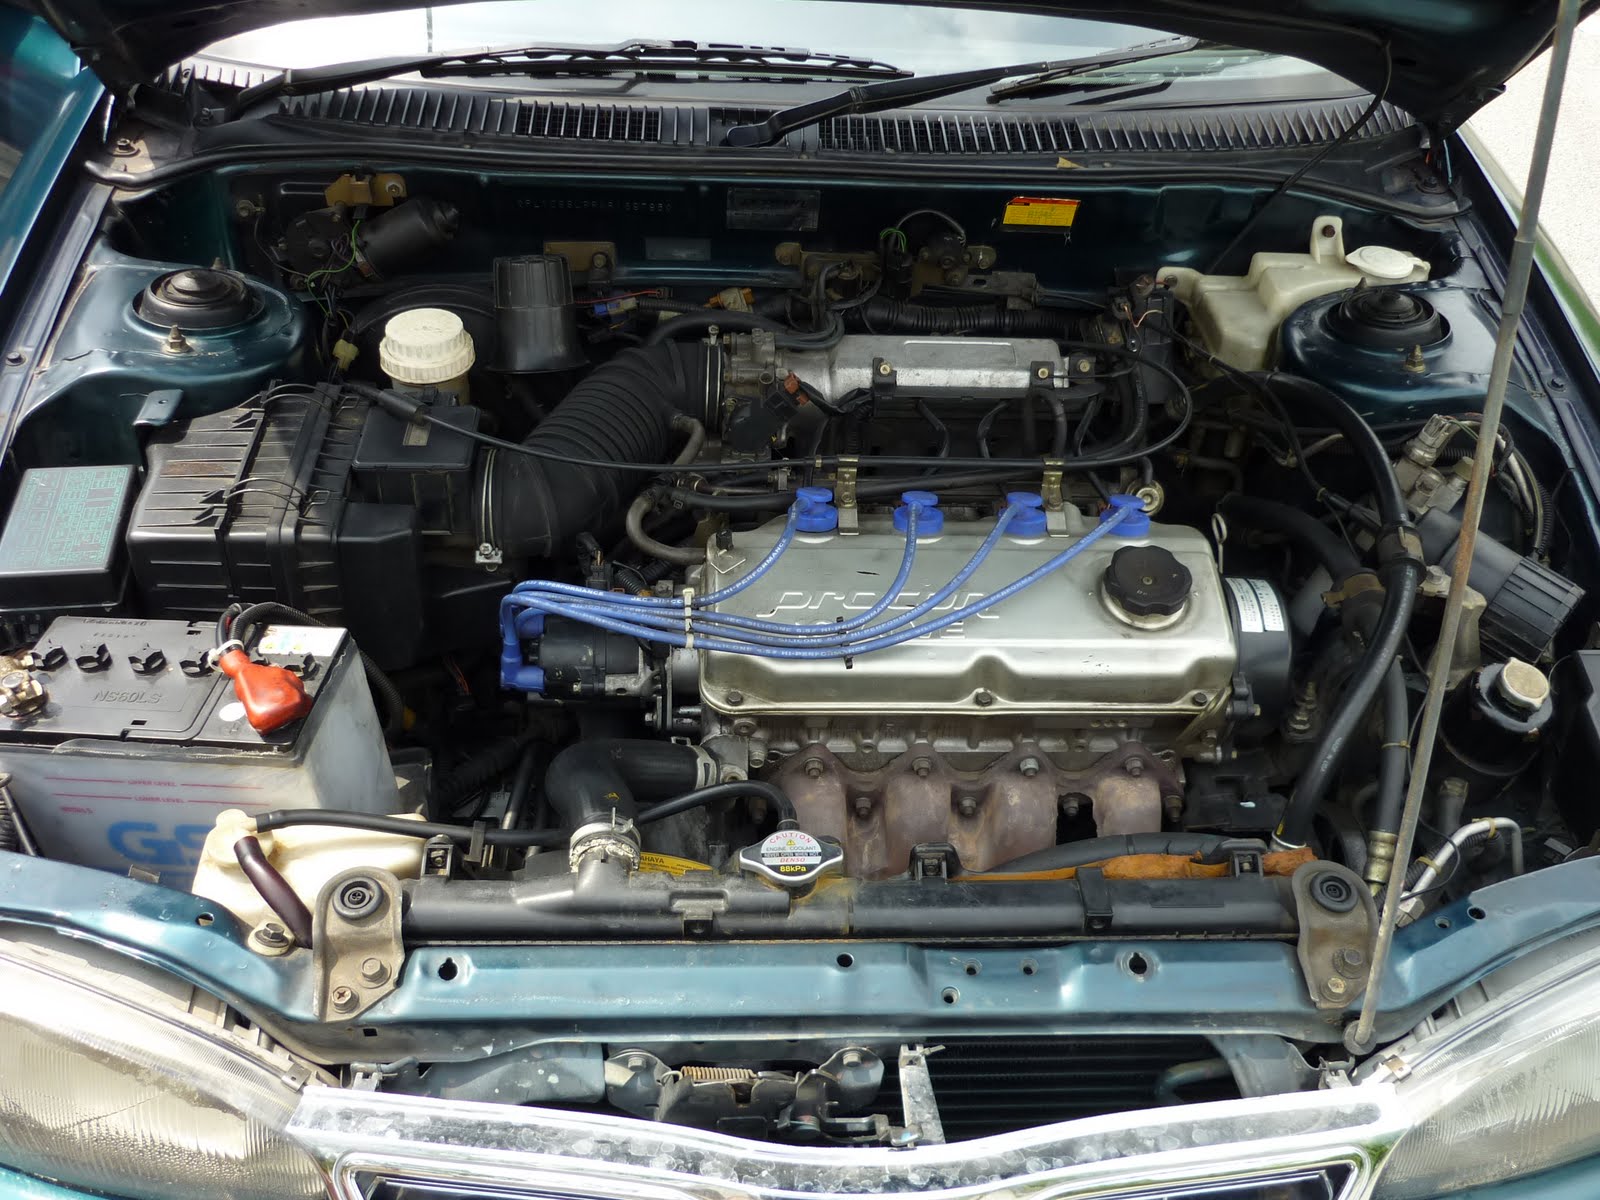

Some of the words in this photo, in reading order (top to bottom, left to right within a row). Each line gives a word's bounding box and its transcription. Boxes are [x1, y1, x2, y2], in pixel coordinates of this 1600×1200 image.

[722, 537, 787, 596] HI-PERFORMANCE
[820, 592, 896, 634] HI-PERFORMANCE
[769, 832, 813, 844] CAUTION
[640, 855, 664, 863] AHAYA
[779, 864, 807, 872] 88kPa
